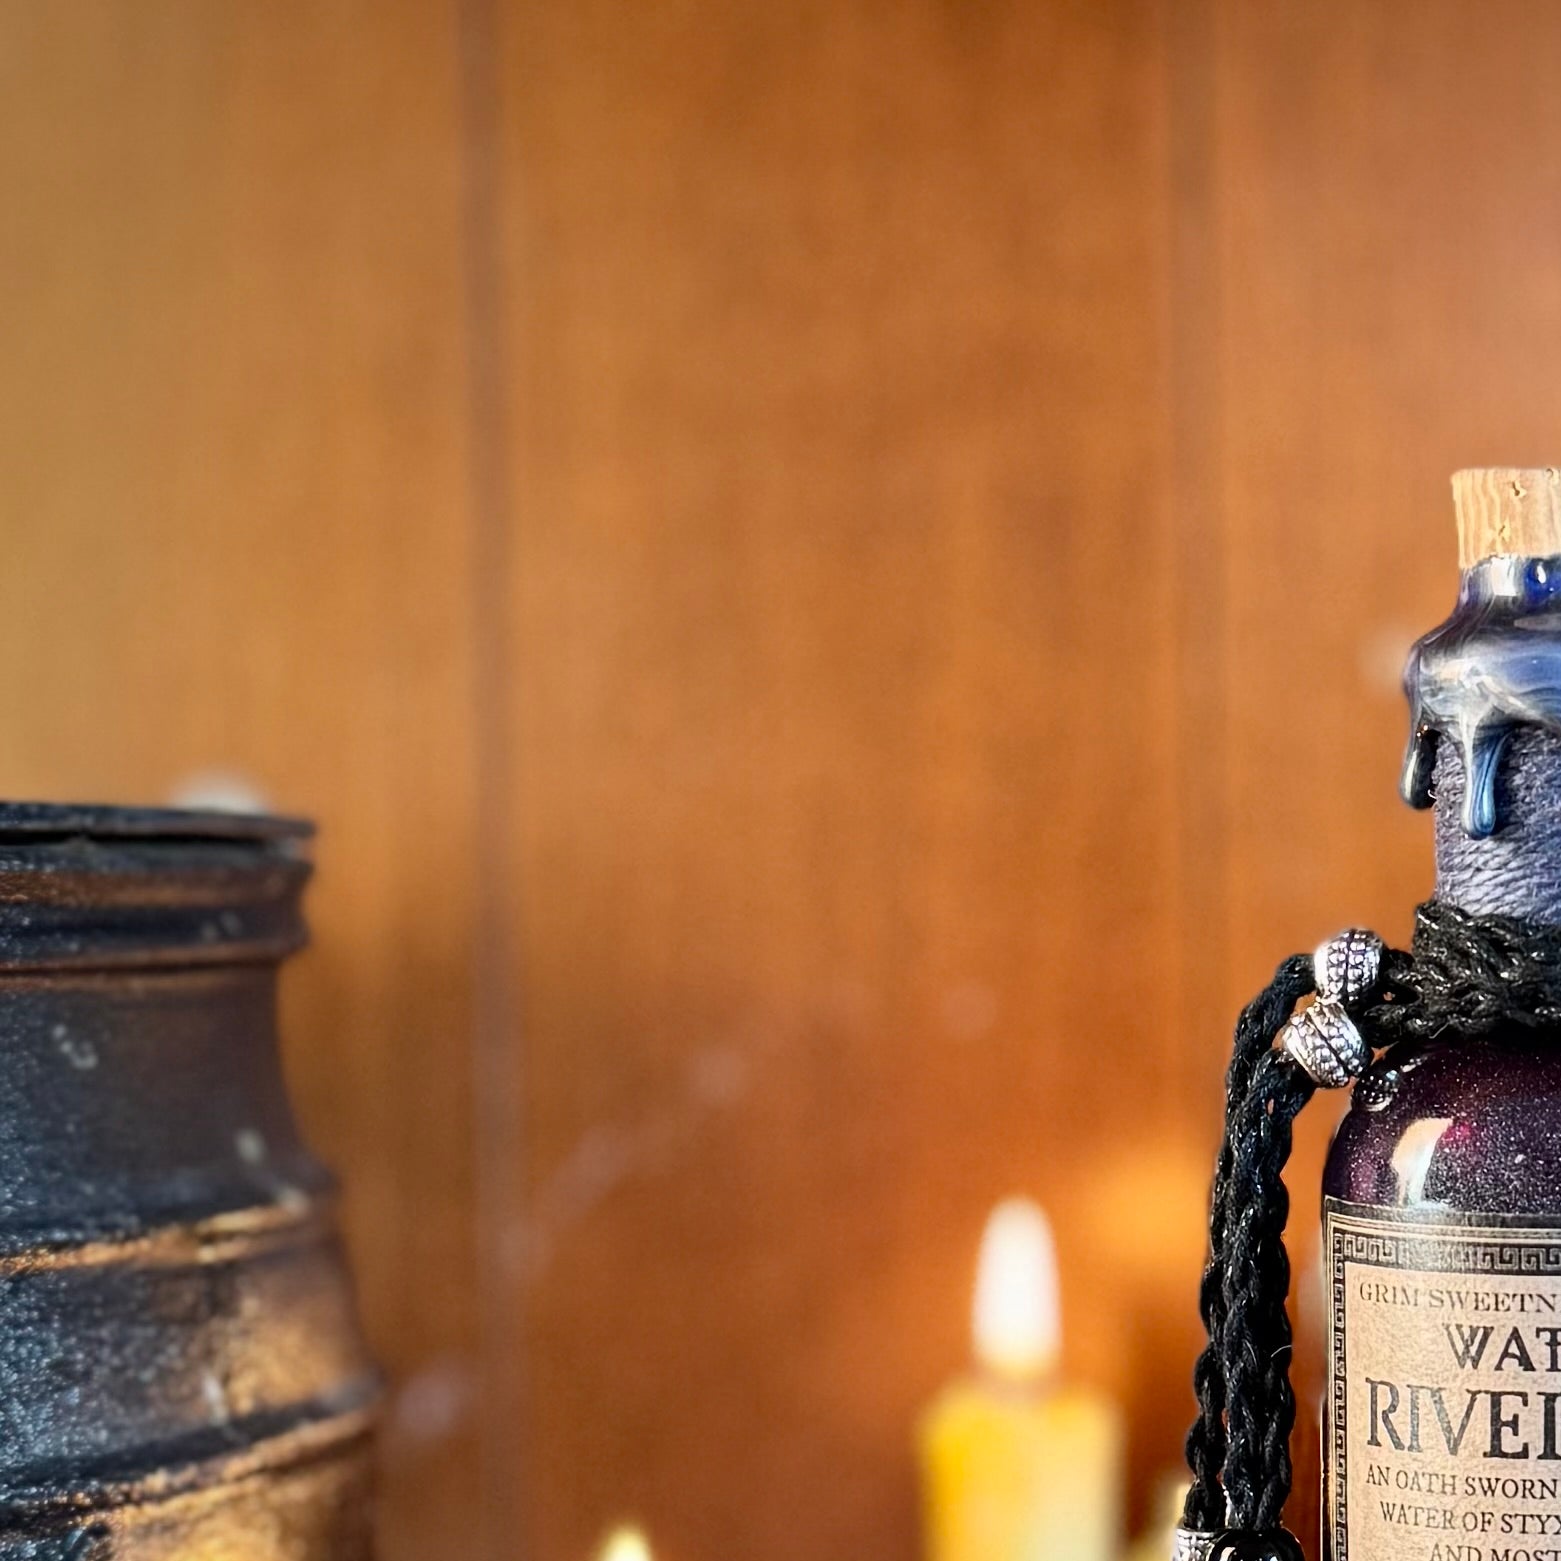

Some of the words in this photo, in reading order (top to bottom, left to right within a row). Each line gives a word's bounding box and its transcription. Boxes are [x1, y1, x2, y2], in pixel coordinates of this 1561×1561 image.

[1360, 1282, 1419, 1308] GRIM
[1366, 1463, 1390, 1486] AN
[1395, 1470, 1458, 1496] OATH
[1464, 1476, 1557, 1500] SWORN
[1379, 1501, 1457, 1530] WATER
[1462, 1511, 1495, 1532] OF
